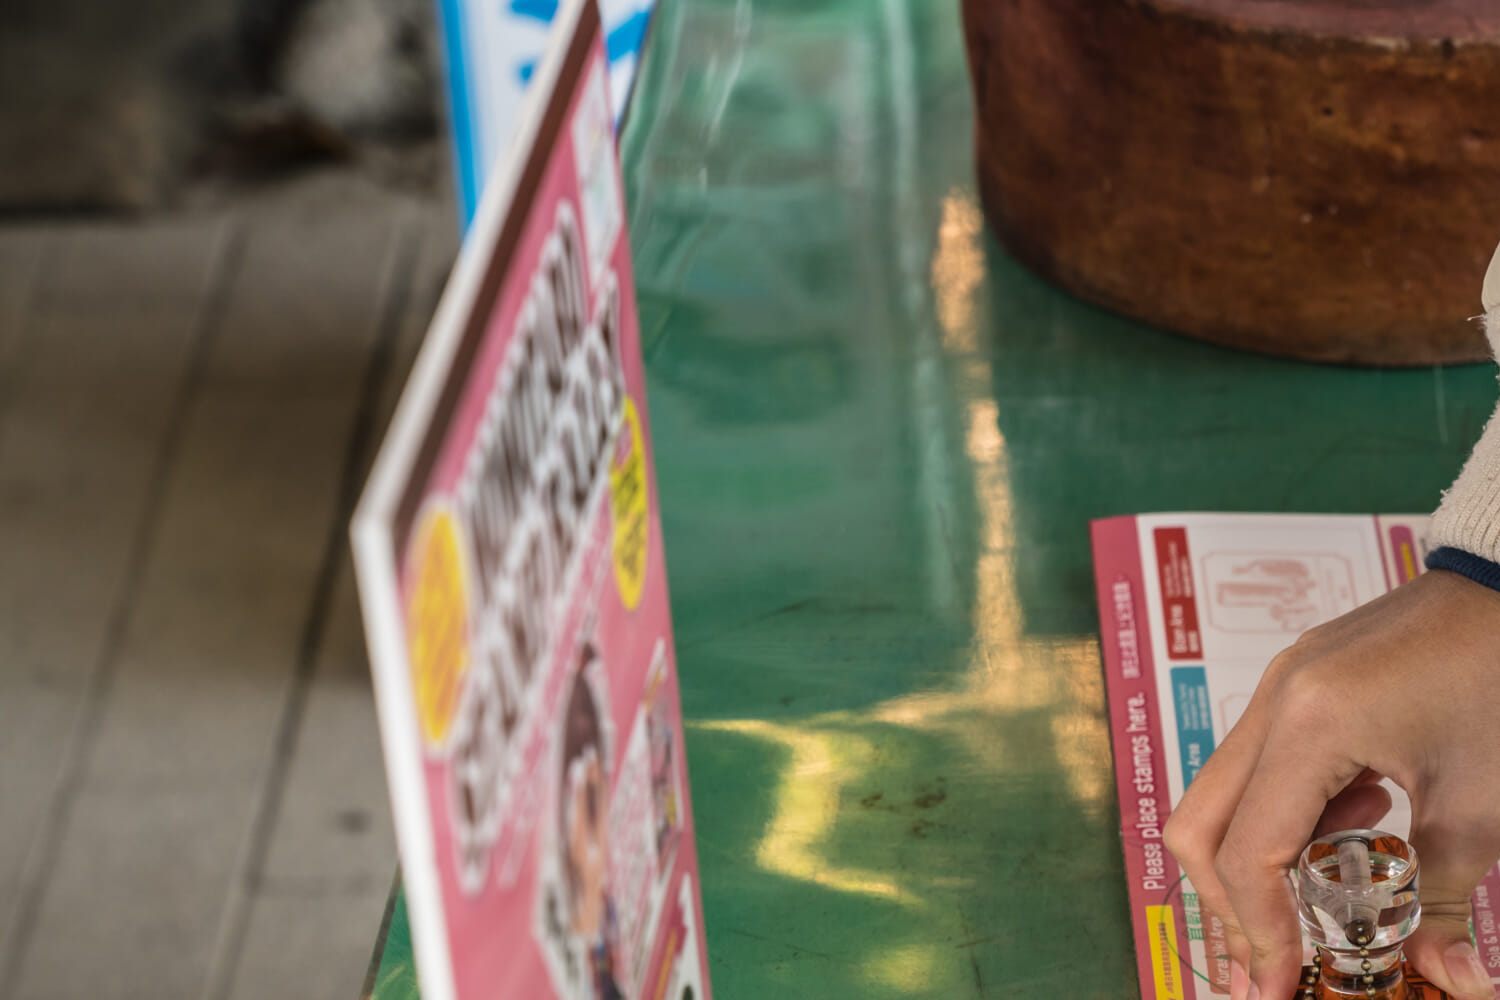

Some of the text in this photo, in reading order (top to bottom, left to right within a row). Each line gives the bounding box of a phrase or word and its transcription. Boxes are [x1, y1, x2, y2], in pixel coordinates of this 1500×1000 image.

[1126, 692, 1147, 732] here.
[1132, 734, 1154, 793] stamps
[1136, 797, 1162, 839] place
[1143, 843, 1166, 890] Please
[1478, 910, 1496, 935] Kibiji
[1483, 936, 1498, 944] &
